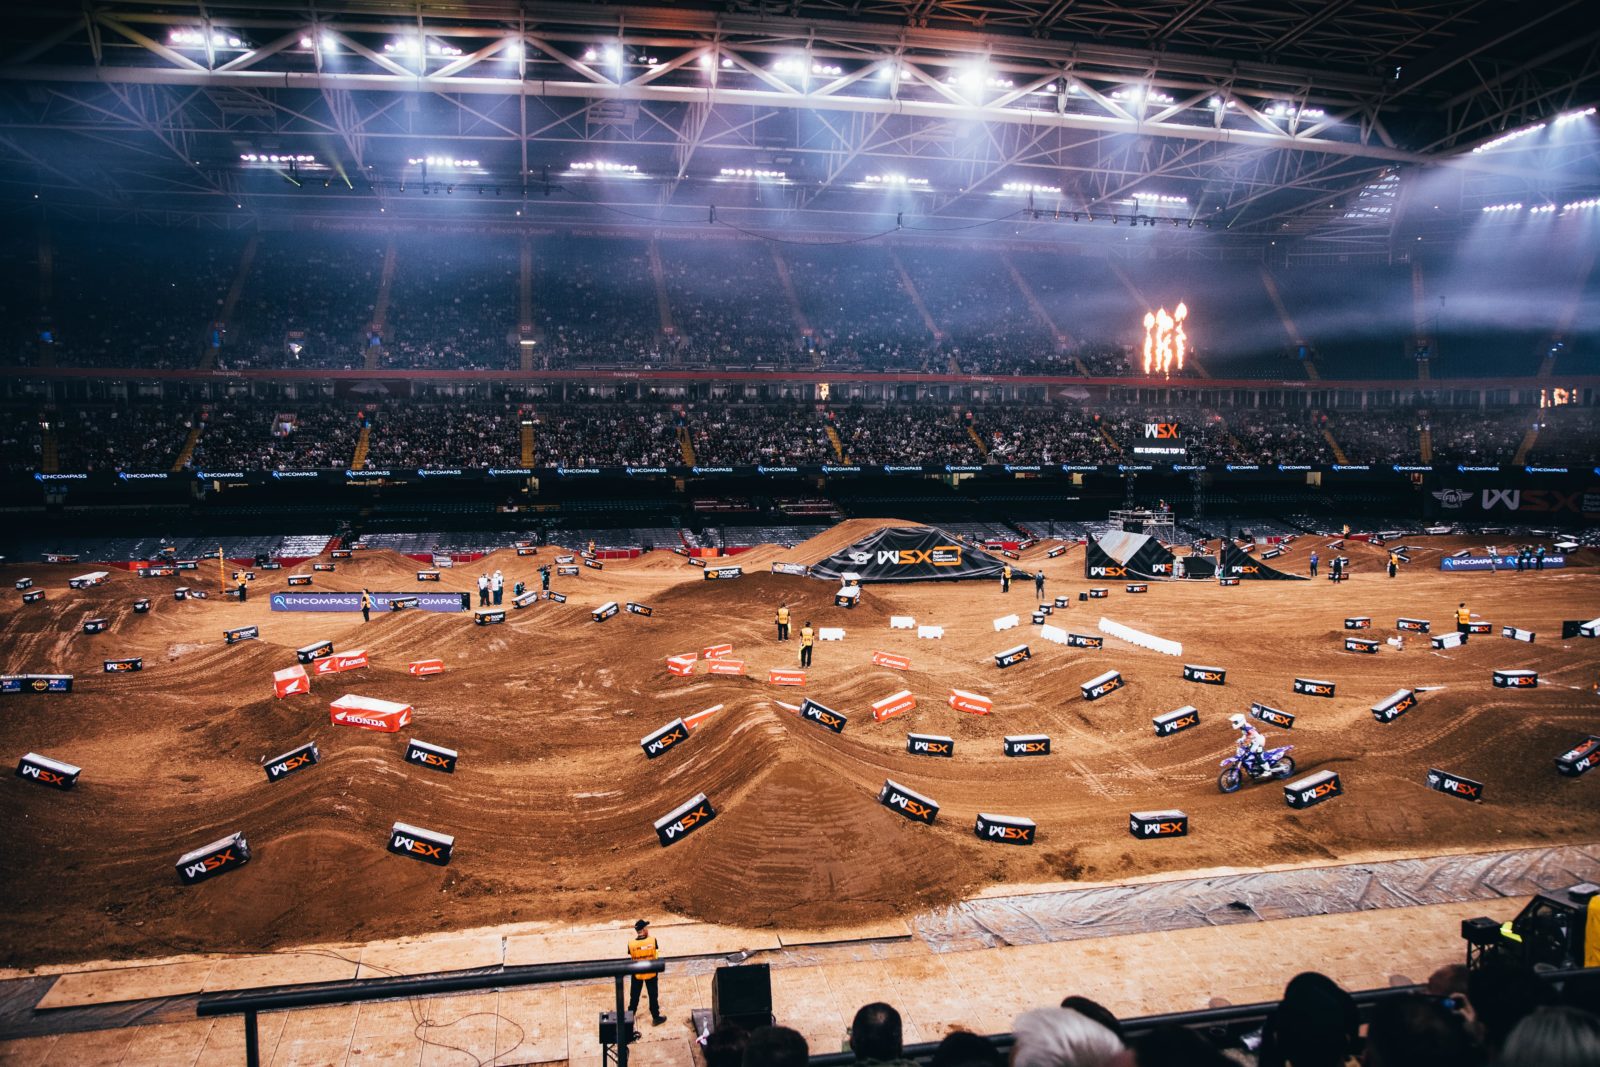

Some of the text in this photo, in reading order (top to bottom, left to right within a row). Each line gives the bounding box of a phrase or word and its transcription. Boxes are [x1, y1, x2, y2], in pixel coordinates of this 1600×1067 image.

[1145, 423, 1178, 438] WSX
[1482, 490, 1581, 512] WSX
[878, 550, 932, 564] WSX
[1090, 566, 1127, 577] WSX
[1152, 564, 1173, 573] WS
[1232, 566, 1259, 574] WSX
[1398, 621, 1422, 629] WSX
[1076, 637, 1100, 647] WSX
[308, 646, 330, 660] WSX
[1002, 651, 1028, 665] WSX
[1193, 671, 1222, 682] WSX
[1507, 676, 1535, 686] WSX
[1091, 678, 1119, 698] WSX
[1304, 684, 1332, 695] WSX
[888, 700, 912, 713] HONDA
[964, 703, 988, 713] HONDA
[1385, 697, 1413, 719] WSX
[346, 716, 388, 728] HONDA
[808, 706, 842, 728] WSX
[1164, 714, 1196, 733] WSX
[1262, 710, 1291, 726] WSX
[648, 729, 683, 754] WSX
[914, 741, 948, 753] WSX
[1014, 742, 1046, 753] WSX
[1562, 739, 1595, 760] WSX
[270, 752, 310, 776] WSX
[412, 750, 450, 768] WSX
[22, 764, 64, 786] WSX
[1302, 780, 1338, 802] WSX
[1444, 778, 1478, 797] WSX
[890, 792, 932, 819] WSX
[666, 806, 710, 838] WSX
[1144, 822, 1182, 834] WSX
[988, 825, 1030, 840] WSX
[394, 835, 441, 859] WSX
[185, 849, 235, 878] WSX
